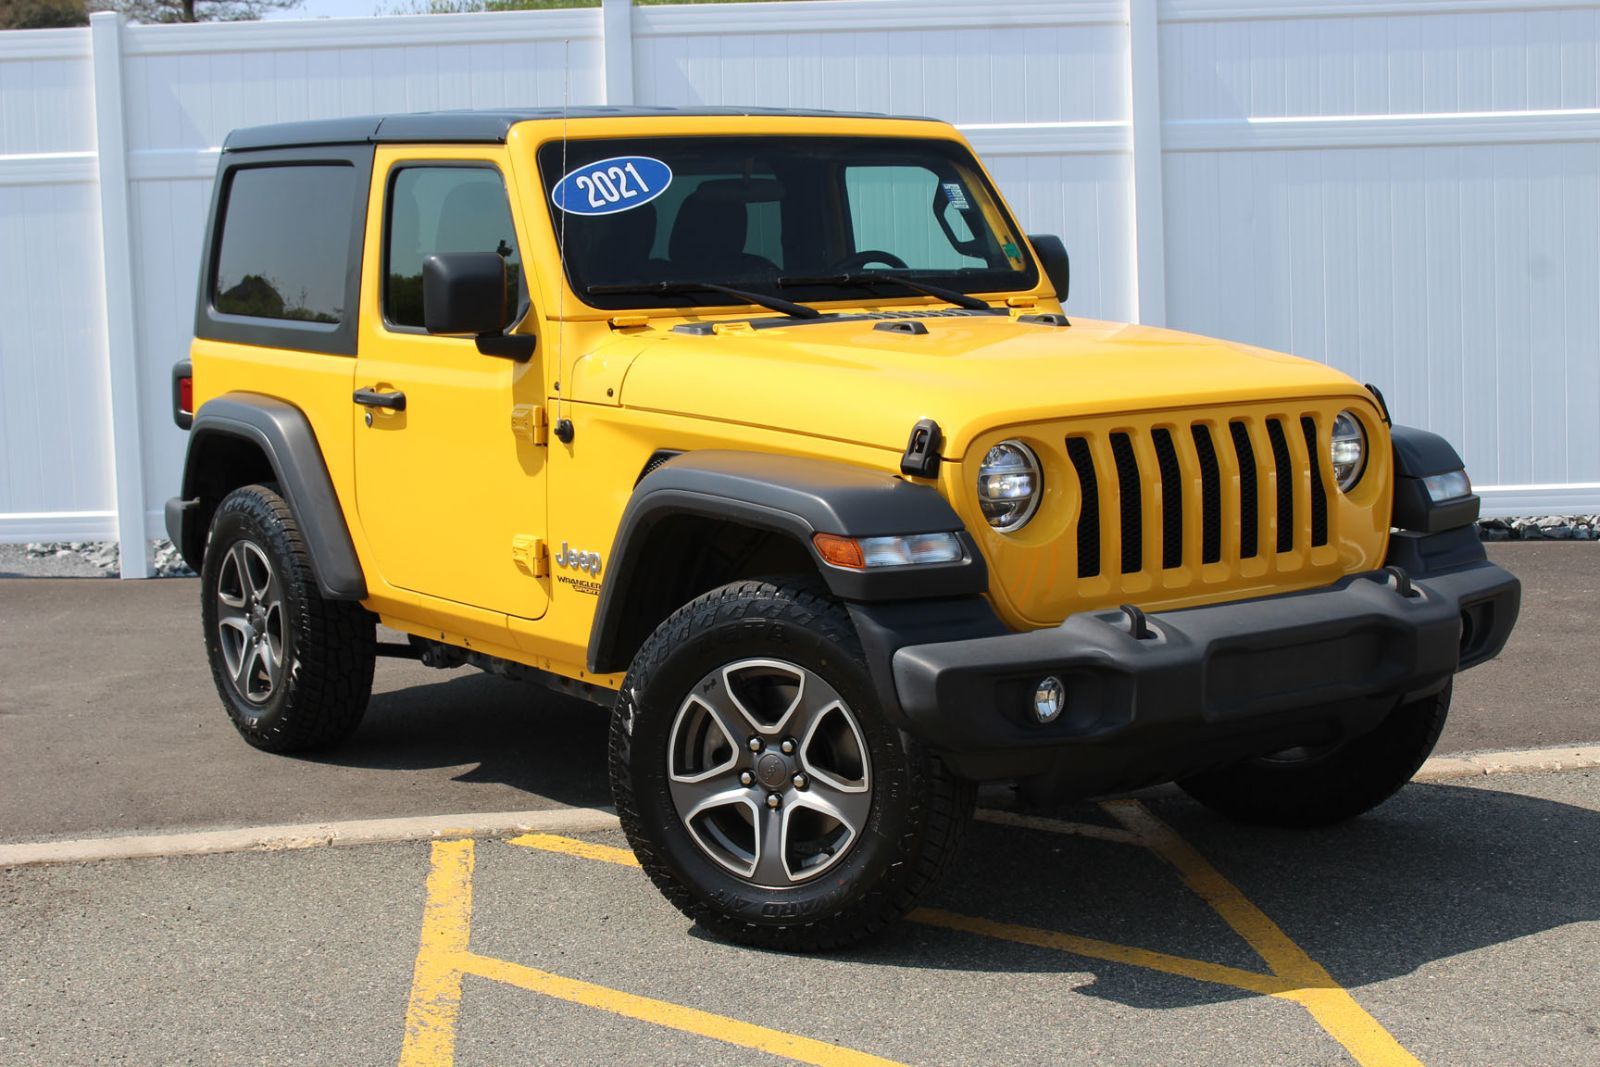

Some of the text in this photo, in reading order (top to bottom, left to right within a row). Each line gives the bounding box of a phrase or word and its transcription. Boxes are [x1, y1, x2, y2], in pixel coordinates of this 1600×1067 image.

[576, 162, 649, 208] 2021
[555, 540, 602, 577] Jeep
[556, 575, 601, 589] WRANGLER
